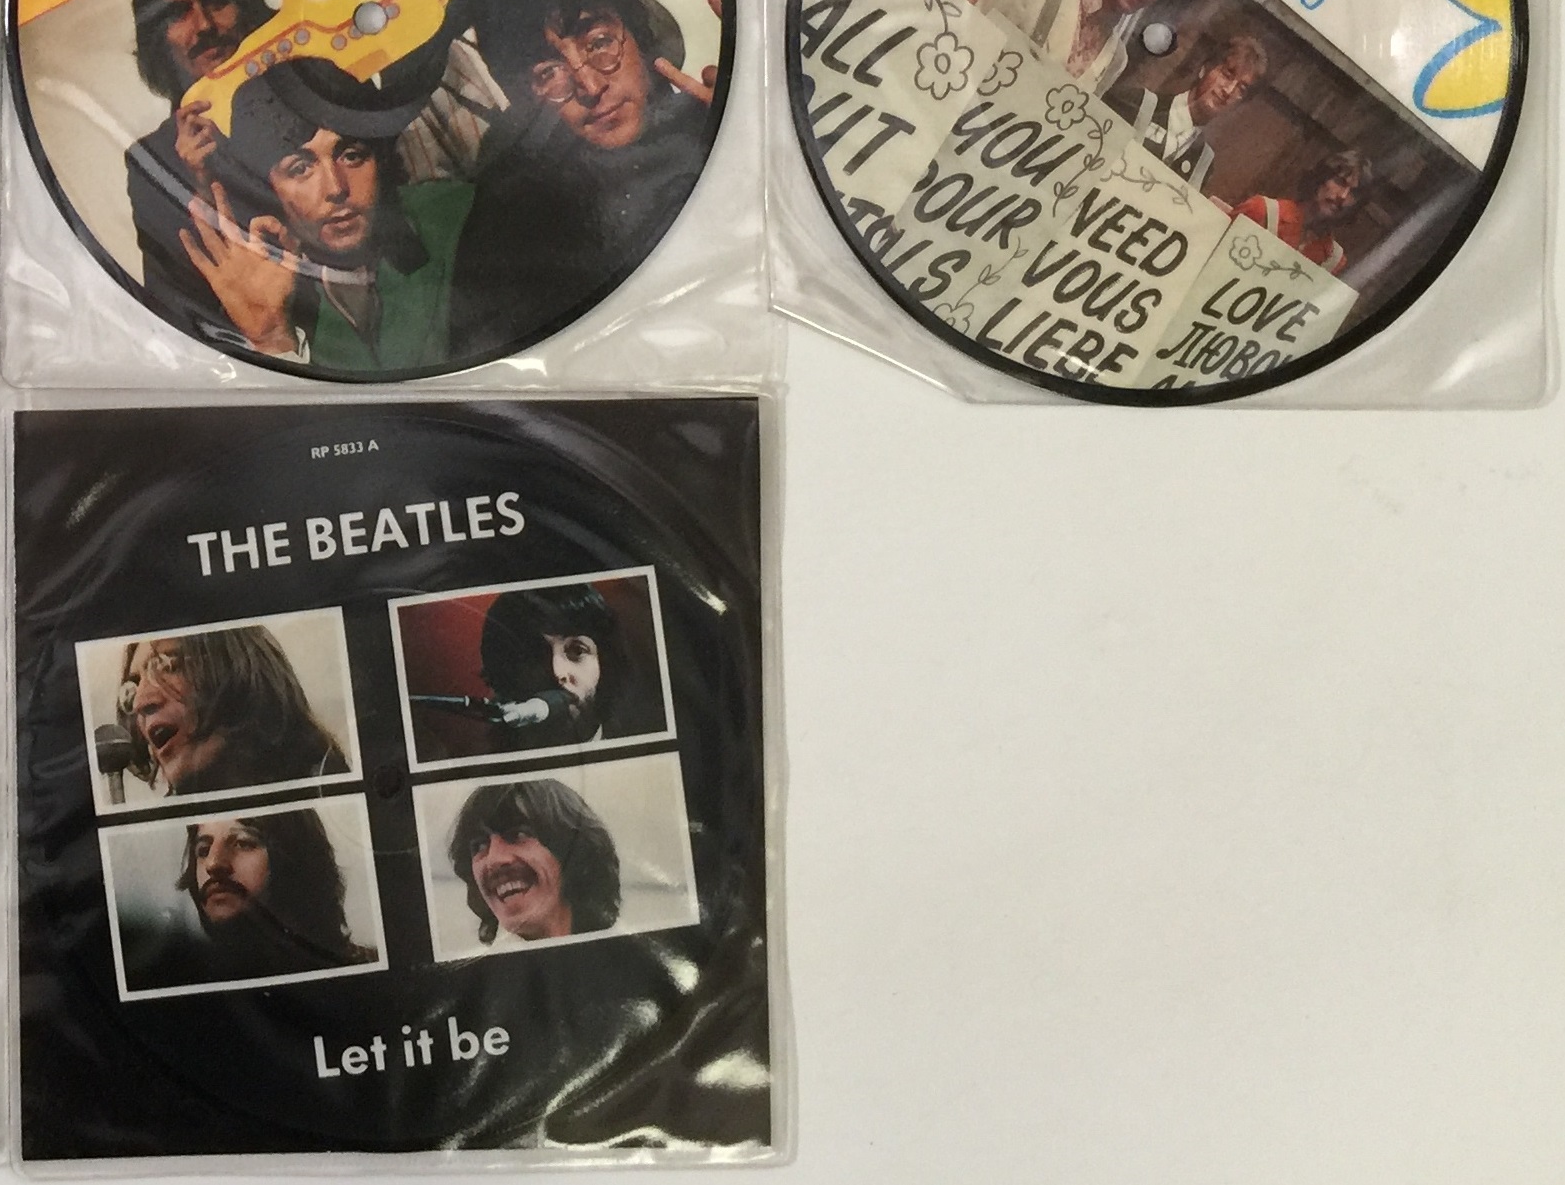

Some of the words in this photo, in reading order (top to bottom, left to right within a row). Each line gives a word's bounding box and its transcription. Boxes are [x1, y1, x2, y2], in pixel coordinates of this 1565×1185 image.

[950, 101, 1086, 187] YOU
[1200, 278, 1321, 344] LOVE
[1021, 239, 1163, 334] VOUS
[311, 445, 330, 459] RP
[333, 441, 364, 456] 5833
[367, 438, 379, 452] A
[187, 521, 292, 577] THE
[305, 491, 526, 561] BEATLES
[313, 1034, 387, 1078] Let
[401, 1024, 434, 1067] it
[447, 1016, 510, 1061] be
